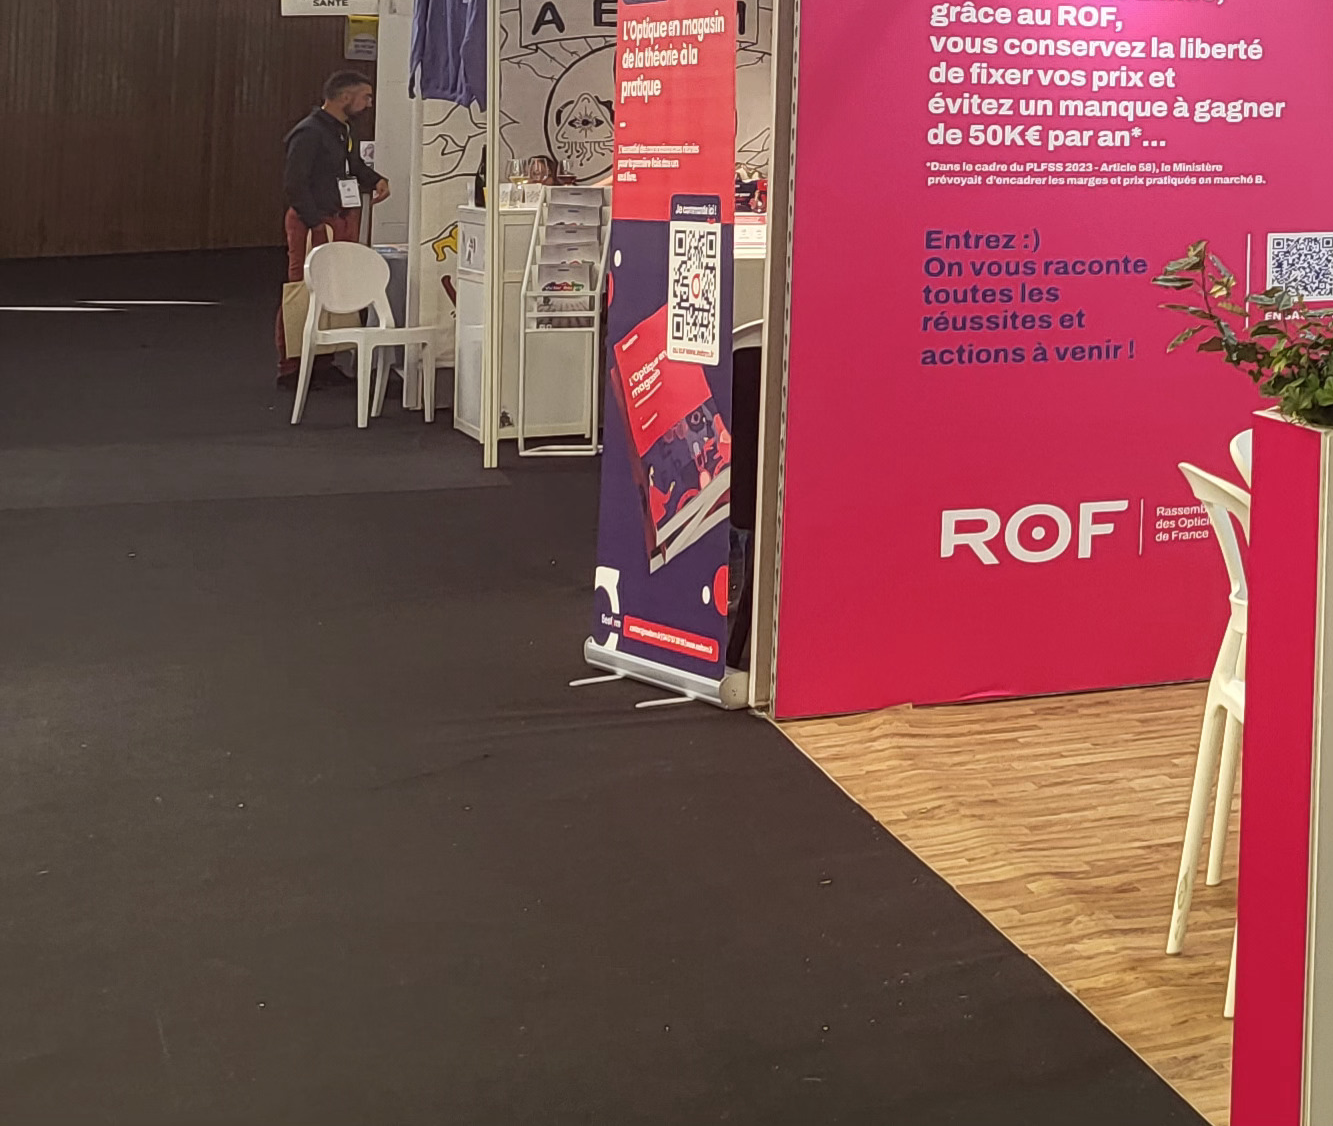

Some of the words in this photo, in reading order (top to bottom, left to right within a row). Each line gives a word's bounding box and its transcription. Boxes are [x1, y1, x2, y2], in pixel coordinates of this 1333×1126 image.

[623, 17, 666, 44] L'Optique
[682, 10, 725, 41] magasin
[930, 2, 1012, 28] grâce
[1016, 8, 1052, 27] au
[1057, 5, 1123, 32] ROF,
[622, 51, 634, 68] de
[635, 49, 645, 66] la
[645, 44, 679, 66] théorie
[680, 44, 689, 65] à
[690, 48, 699, 65] la
[930, 35, 998, 55] vous
[1003, 35, 1146, 59] conservez
[1151, 35, 1174, 58] la
[1179, 36, 1263, 61] liberté
[621, 75, 662, 103] pratique
[928, 64, 965, 86] de
[969, 64, 1033, 87] fixer
[1037, 68, 1088, 87] vos
[1092, 67, 1145, 93] prix
[1148, 69, 1176, 89] et
[928, 92, 1014, 117] évitez
[1019, 99, 1055, 117] un
[1059, 98, 1169, 124] manque
[1173, 93, 1190, 119] à
[1194, 97, 1287, 125] gagner
[927, 123, 964, 146] de
[968, 124, 1043, 147] 50K€
[1048, 128, 1094, 150] par
[962, 162, 973, 171] le
[974, 162, 1008, 172] cadre
[1009, 162, 1025, 172] du
[1026, 162, 1064, 172] PLFSS
[1065, 162, 1092, 172] 2023
[1100, 162, 1137, 172] Article
[1138, 163, 1159, 173] 58),
[1161, 162, 1171, 172] le
[1172, 162, 1223, 172] Ministère
[927, 175, 982, 186] prévoyait
[985, 175, 1047, 185] d'encadrer
[1048, 175, 1065, 185] les
[1066, 176, 1109, 187] marges
[1110, 176, 1121, 185] et
[1122, 175, 1145, 187] prix
[1145, 175, 1197, 187] pratiqués
[1198, 176, 1213, 185] en
[1213, 175, 1253, 185] marché
[1254, 175, 1266, 184] B.
[925, 230, 1016, 250] Entrez
[1023, 229, 1041, 253] :)
[923, 257, 964, 278] On
[969, 258, 1036, 278] vous
[1042, 254, 1148, 276] raconte
[923, 285, 1013, 305] toutes
[1019, 283, 1060, 304] les
[922, 311, 1052, 332] réussites
[1058, 310, 1086, 329] et
[921, 344, 1026, 365] actions
[1034, 338, 1049, 363] à
[1055, 339, 1123, 361] venir
[940, 499, 1129, 565] ROF
[1155, 531, 1170, 542] de
[1172, 530, 1209, 540] France
[1156, 519, 1176, 529] des
